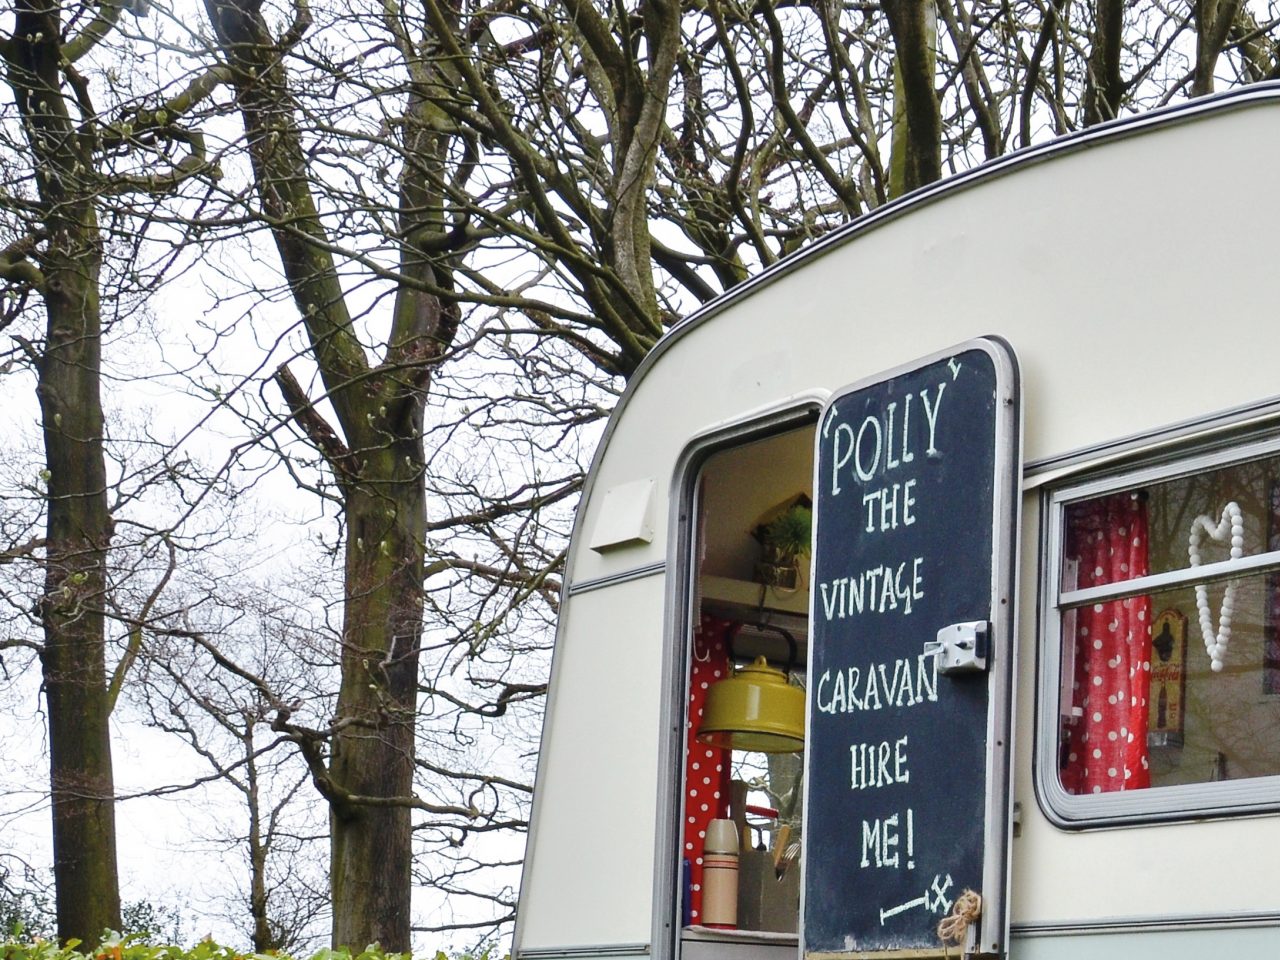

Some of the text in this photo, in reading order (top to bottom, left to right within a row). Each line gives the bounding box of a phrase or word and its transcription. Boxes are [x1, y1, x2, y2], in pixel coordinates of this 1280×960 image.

[863, 478, 917, 533] THE
[819, 556, 924, 621] VINTAGE
[817, 653, 939, 715] CARAVAN
[850, 735, 910, 790] HIRE
[860, 808, 915, 869] ME!
